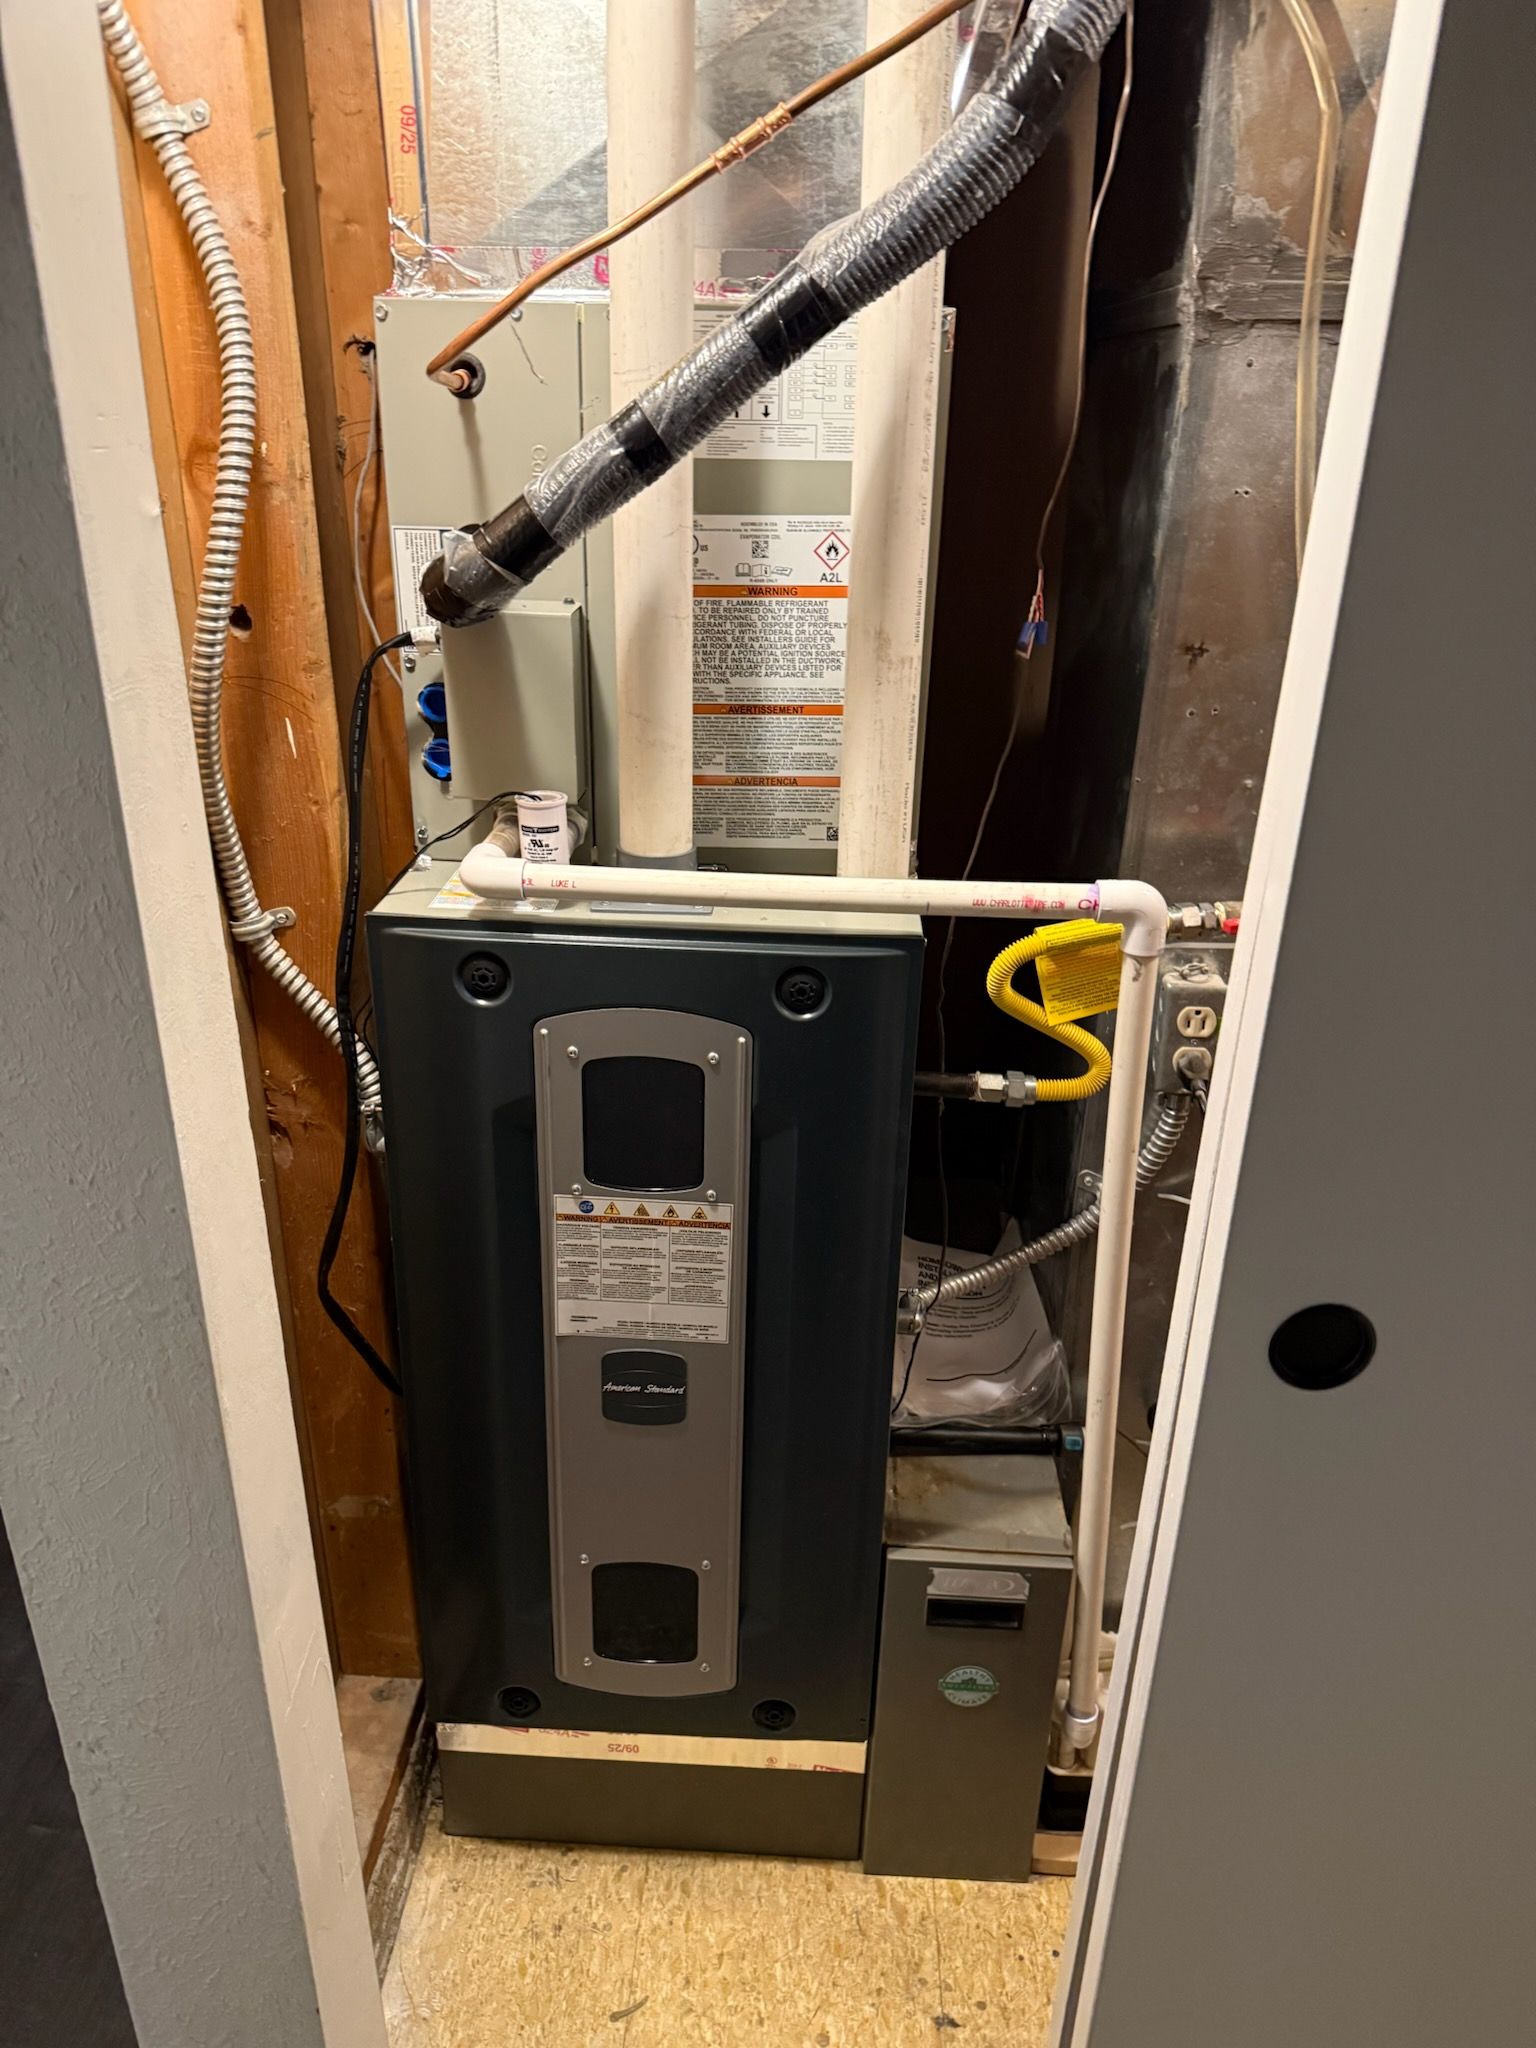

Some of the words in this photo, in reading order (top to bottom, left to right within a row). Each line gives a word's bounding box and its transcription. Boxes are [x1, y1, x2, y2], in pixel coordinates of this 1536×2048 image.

[400, 105, 416, 154] 09/25
[820, 572, 842, 582] A2L
[748, 587, 798, 596] WARNING
[728, 706, 804, 714] AVERTISSEMENT
[734, 778, 798, 786] ADVERTENCIA
[680, 1220, 730, 1230] ADVERTENCIA
[602, 1381, 641, 1393] American
[644, 1384, 686, 1394] Standard
[608, 1743, 640, 1754] 09/25
